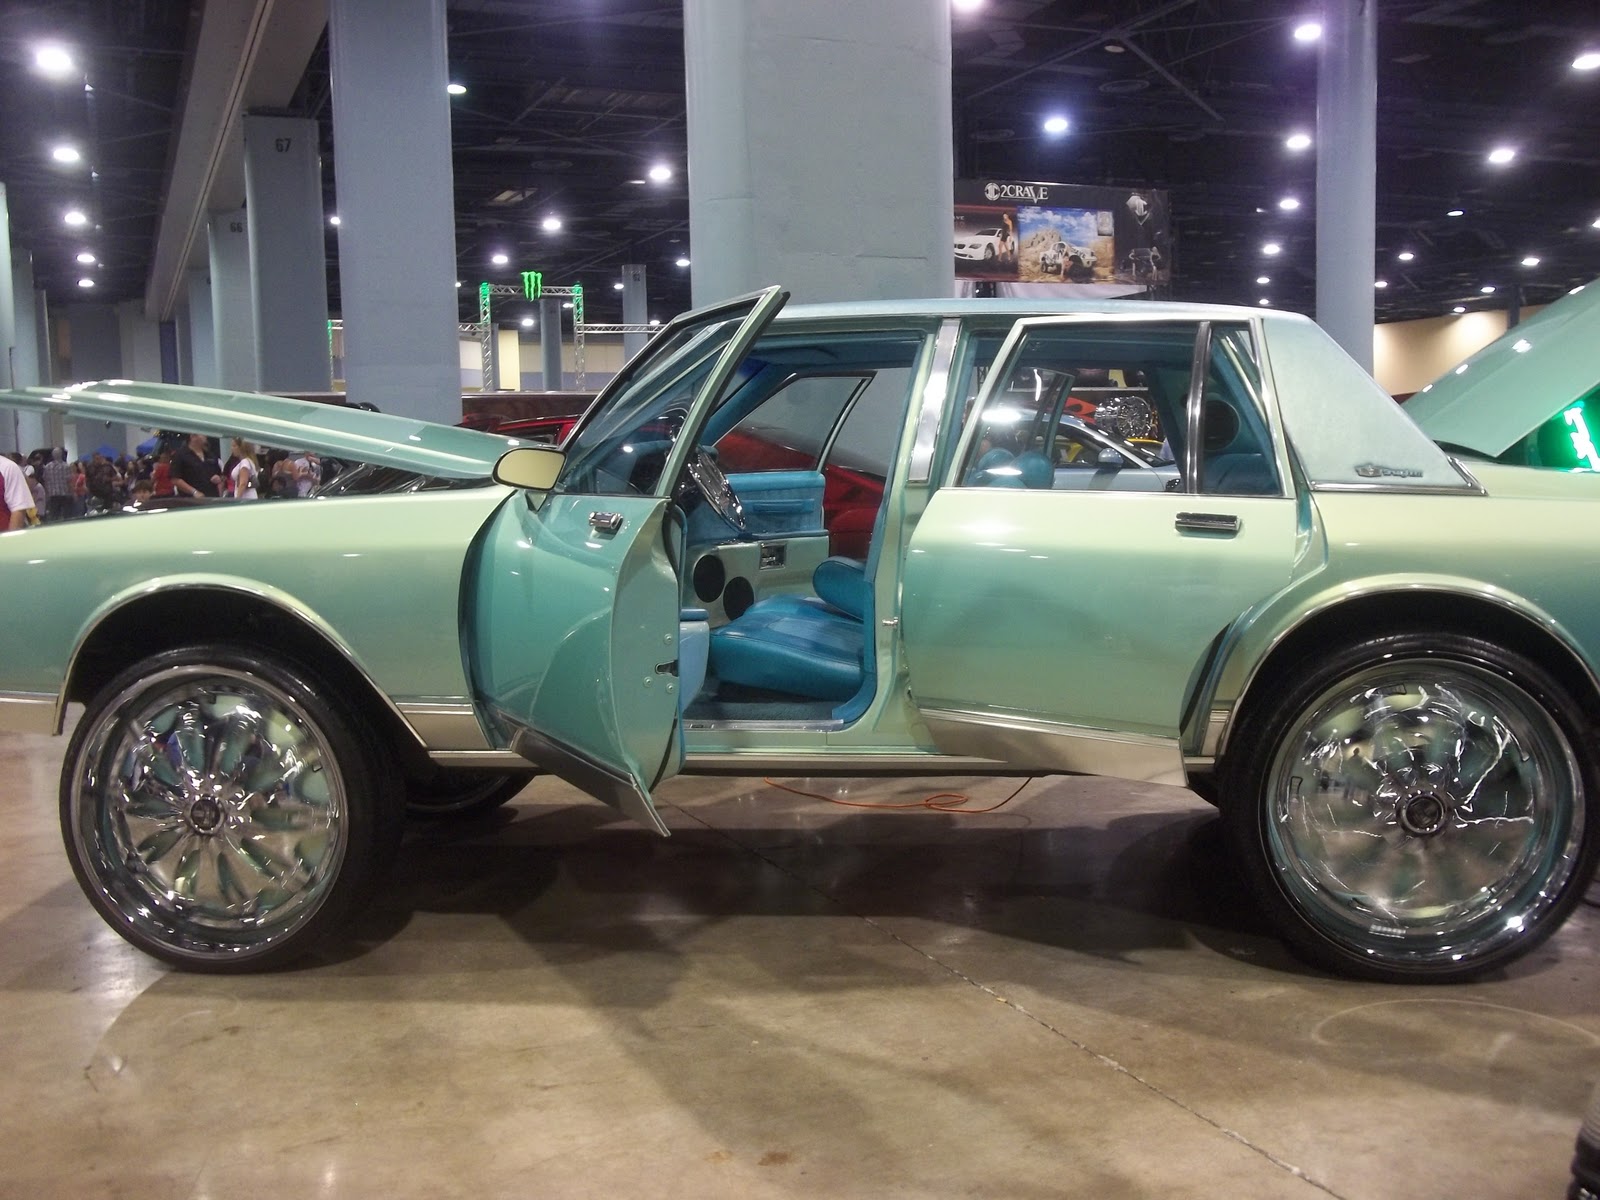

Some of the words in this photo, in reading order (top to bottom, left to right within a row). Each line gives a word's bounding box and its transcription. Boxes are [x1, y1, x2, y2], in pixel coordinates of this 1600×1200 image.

[275, 138, 291, 153] 67
[1000, 184, 1049, 204] 2CRAVE
[230, 222, 243, 233] 66
